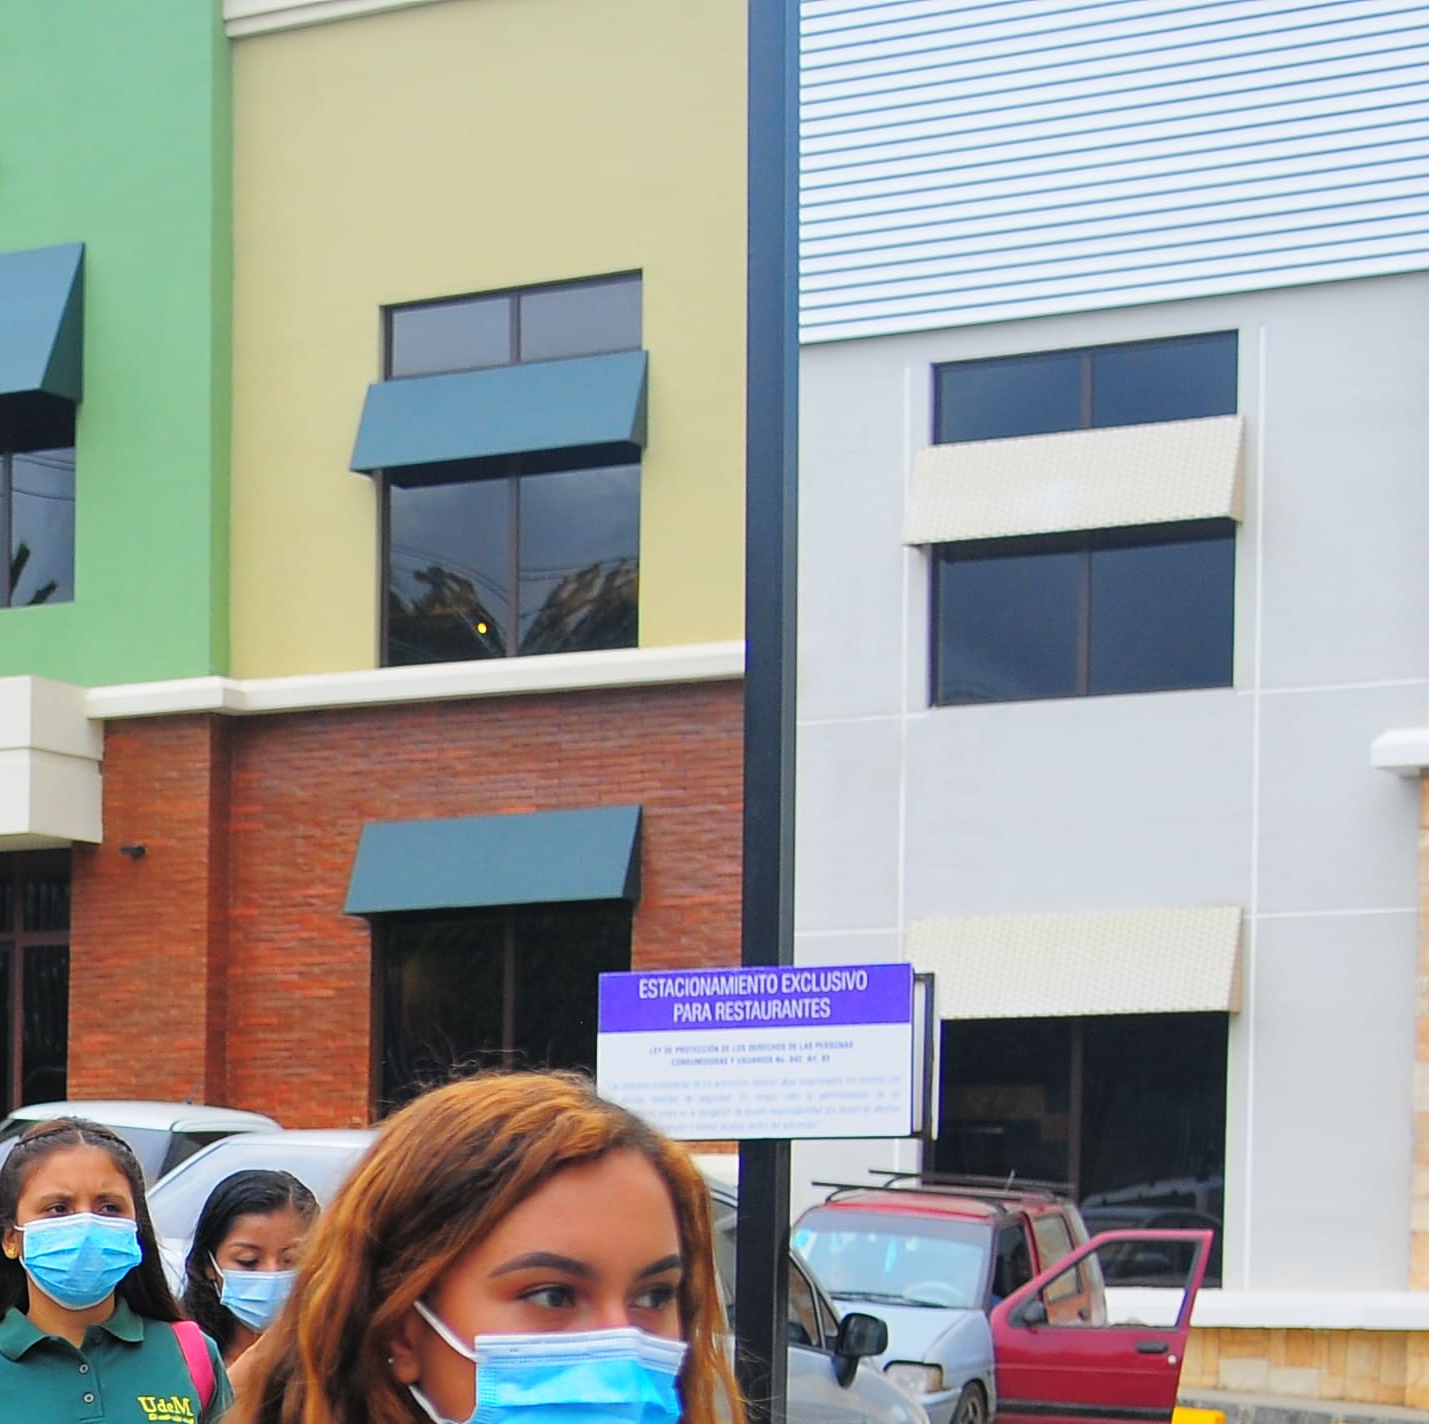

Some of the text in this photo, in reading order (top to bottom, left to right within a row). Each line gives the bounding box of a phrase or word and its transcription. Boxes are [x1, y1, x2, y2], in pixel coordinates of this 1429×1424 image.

[638, 969, 868, 999] ESTACIONAMIENTO EXCLUSIVO
[672, 997, 831, 1023] PARA RESTAURANTES
[137, 1396, 194, 1417] UdeM
